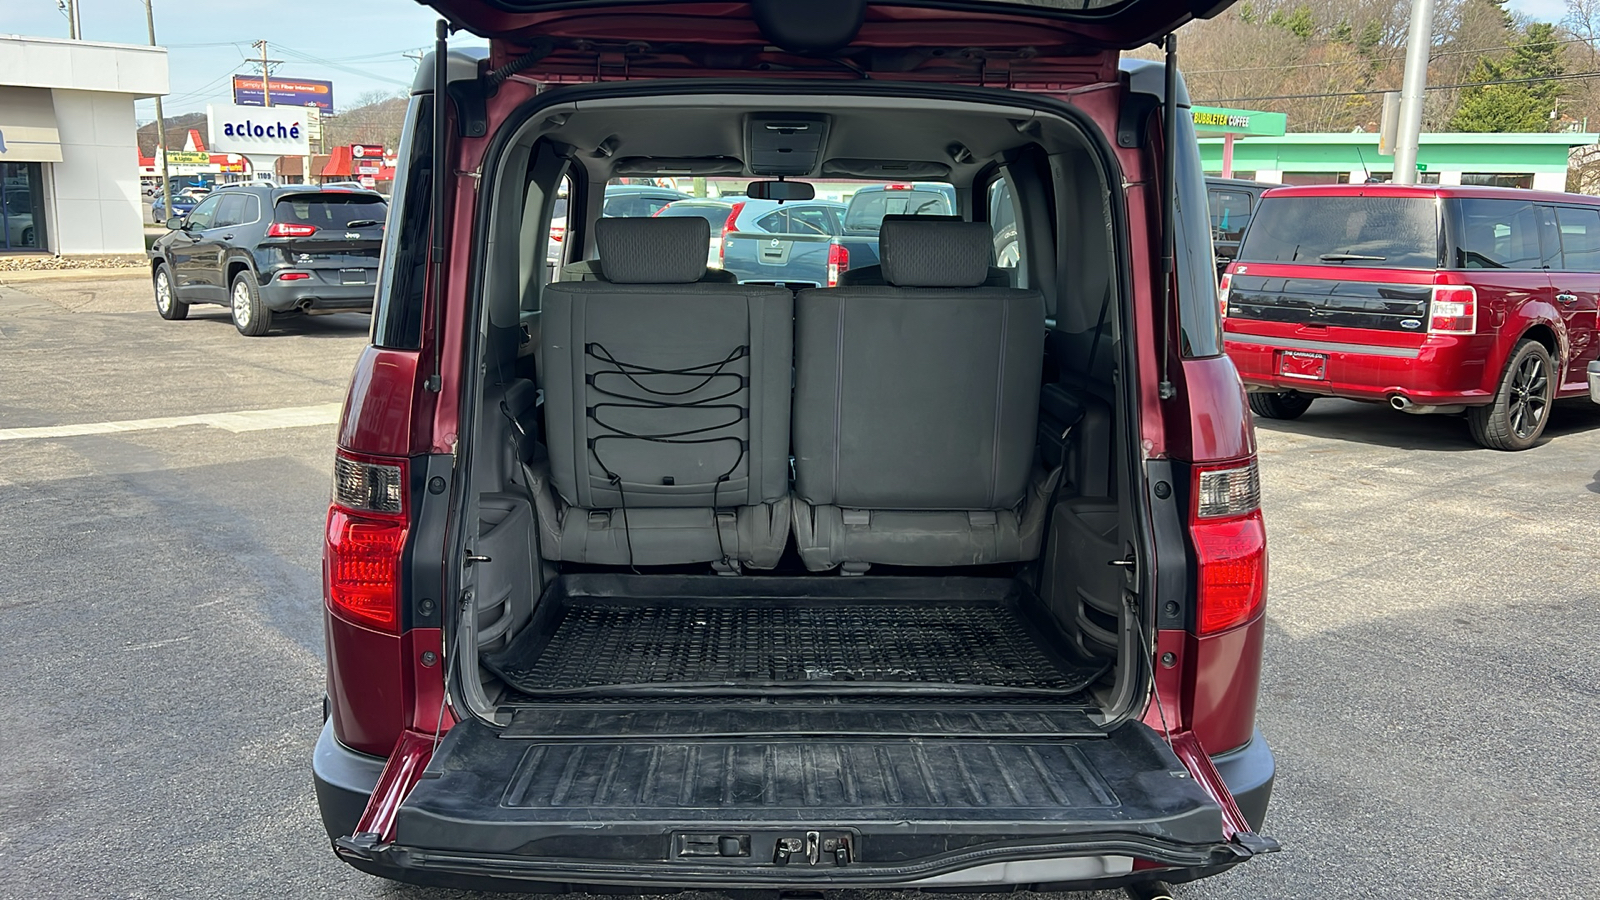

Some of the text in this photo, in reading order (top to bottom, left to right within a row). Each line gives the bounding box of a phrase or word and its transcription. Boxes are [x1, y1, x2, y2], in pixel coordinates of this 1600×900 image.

[1228, 115, 1250, 127] COFFEE
[224, 120, 299, 139] acloché
[257, 172, 271, 180] 1109
